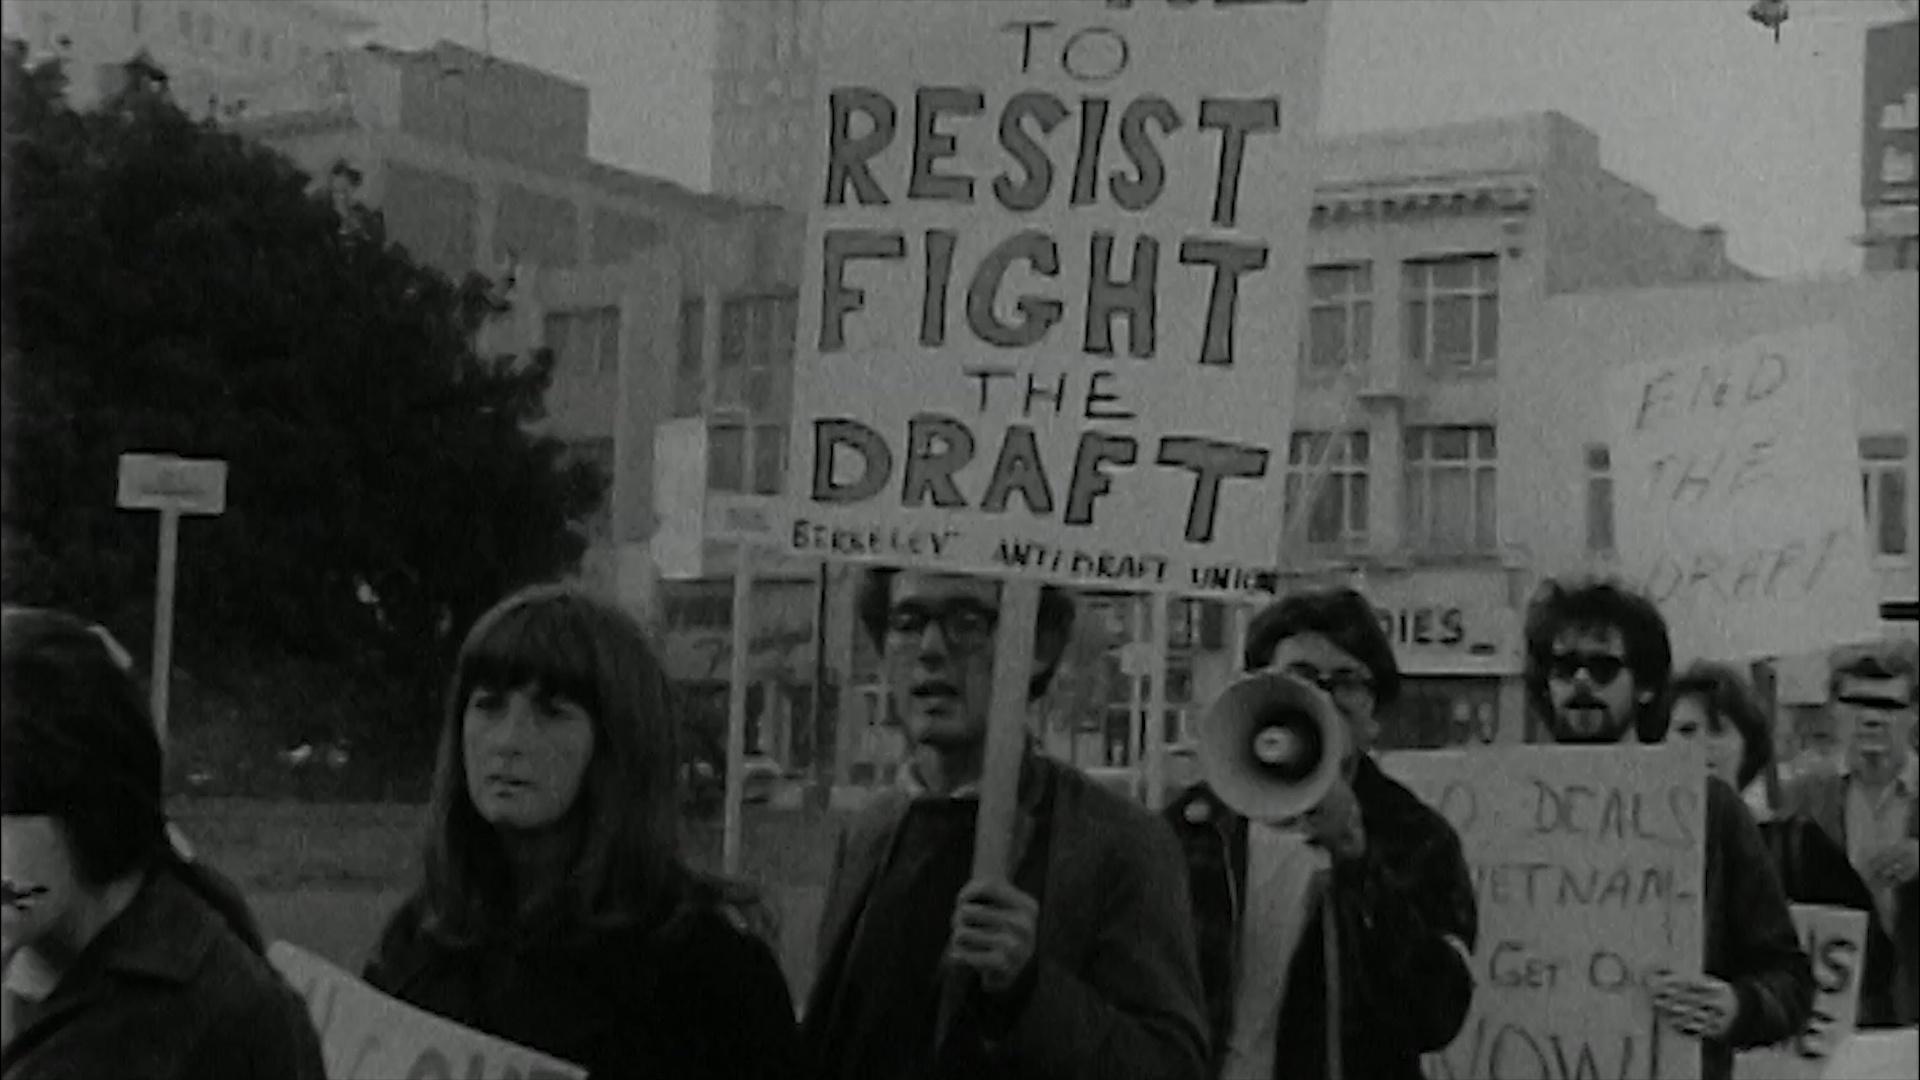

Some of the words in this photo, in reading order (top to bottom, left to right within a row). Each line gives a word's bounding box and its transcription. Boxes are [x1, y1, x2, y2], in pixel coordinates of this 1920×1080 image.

[998, 20, 1128, 82] TO
[824, 86, 1282, 227] RESIST
[820, 229, 1270, 366] FIGHT
[962, 367, 1136, 419] THE
[811, 416, 1270, 543] DRAFT
[1650, 436, 1776, 500] THE
[1533, 779, 1698, 848] DEALS
